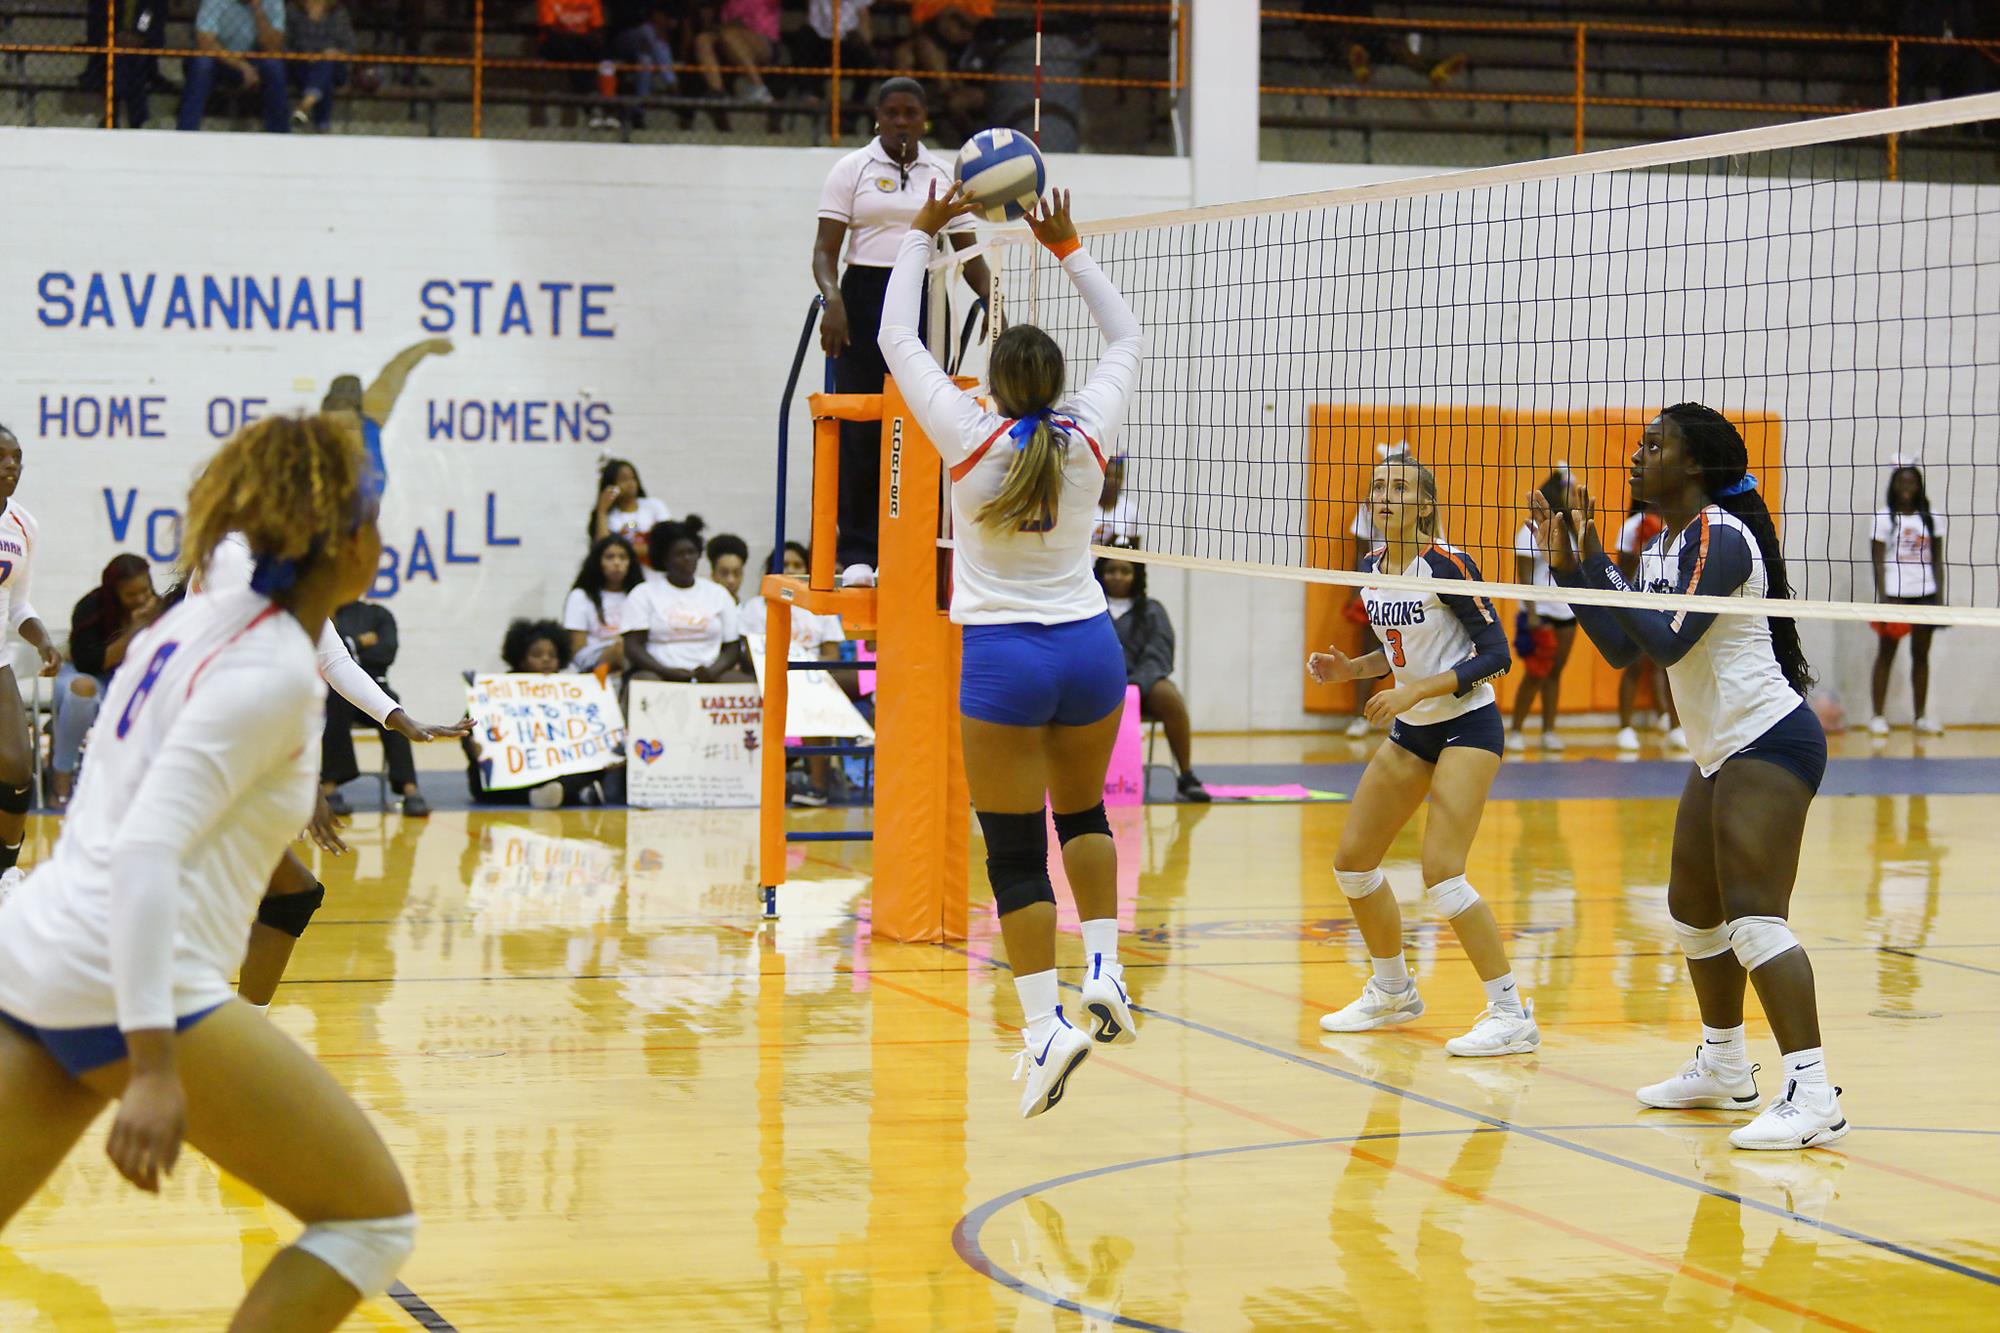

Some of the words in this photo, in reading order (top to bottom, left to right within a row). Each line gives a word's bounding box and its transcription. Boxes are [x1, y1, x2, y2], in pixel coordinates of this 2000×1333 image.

[37, 271, 364, 331] SAVANNAH
[420, 279, 616, 338] STATE
[39, 396, 167, 437] HOME
[427, 400, 614, 443] WOMENS
[1366, 599, 1426, 627] BARONS
[1386, 629, 1406, 667] 3
[710, 712, 760, 725] TATUM
